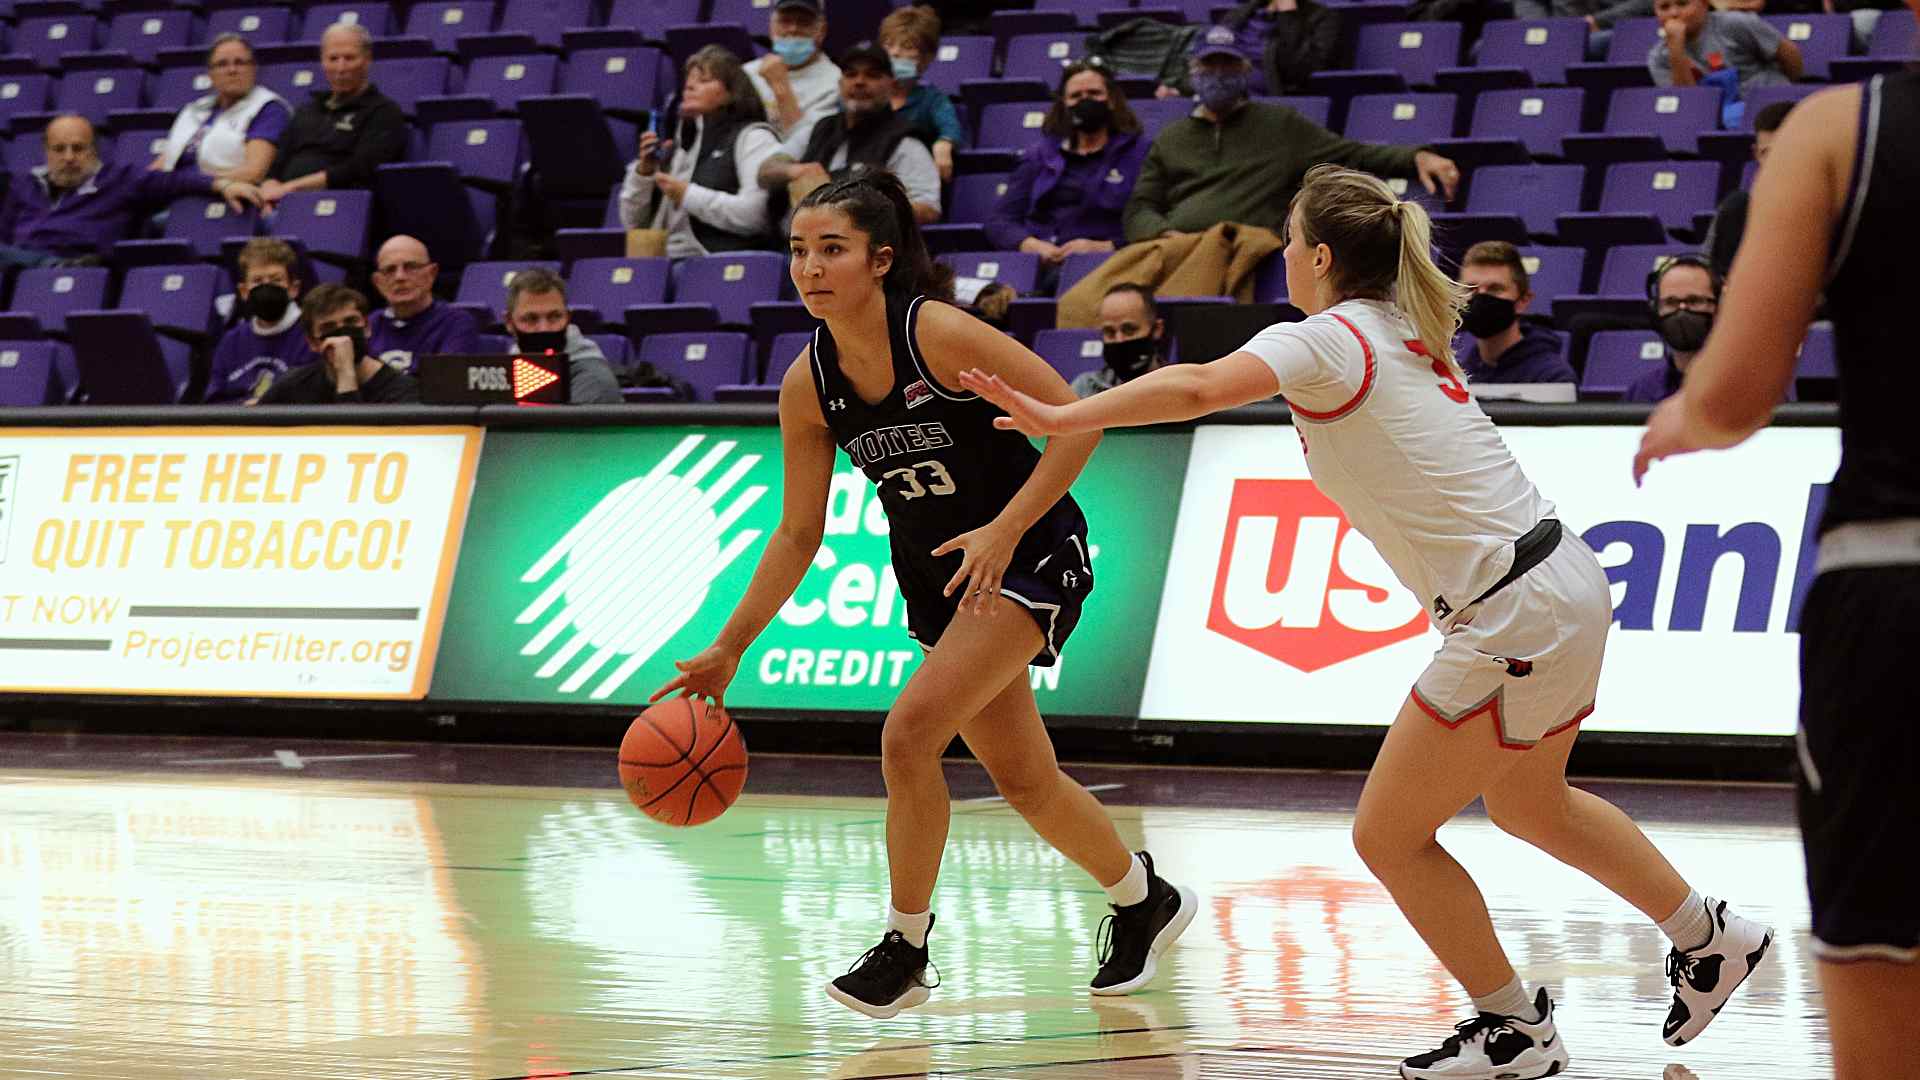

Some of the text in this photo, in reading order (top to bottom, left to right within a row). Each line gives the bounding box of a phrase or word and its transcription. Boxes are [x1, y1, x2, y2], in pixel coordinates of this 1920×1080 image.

[467, 366, 511, 391] POSS.
[845, 422, 953, 469] YOTES
[62, 453, 186, 504] FREE
[199, 452, 326, 505] HELP
[346, 451, 409, 504] TO
[883, 459, 957, 501] 33
[31, 517, 412, 573] QUIT TOBACCO!
[1580, 483, 1837, 634] an
[32, 594, 120, 625] NOW
[122, 630, 413, 672] ProjectFilter.org
[759, 647, 914, 687] CREDIT
